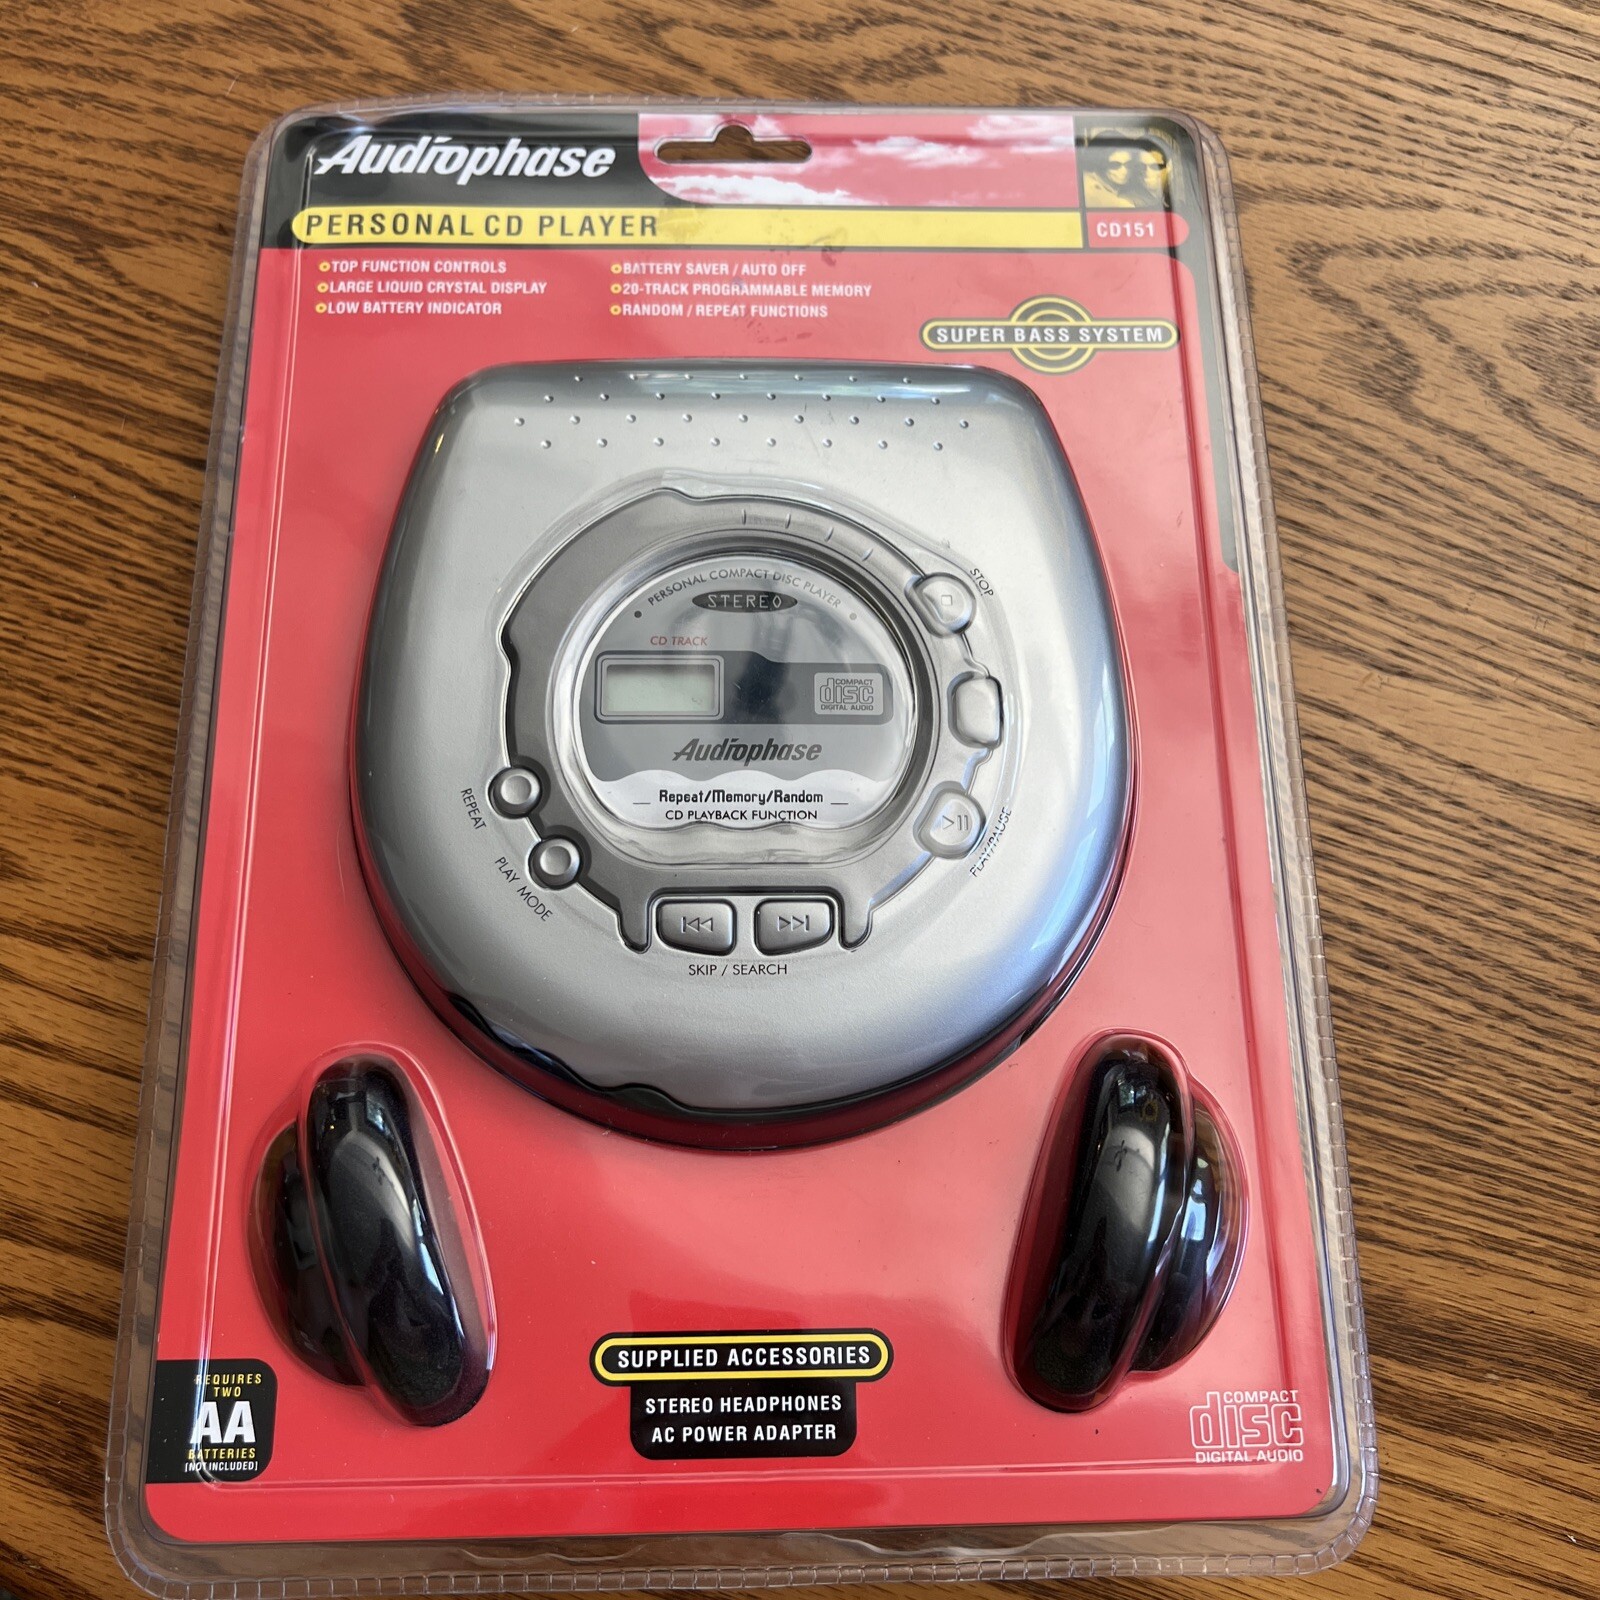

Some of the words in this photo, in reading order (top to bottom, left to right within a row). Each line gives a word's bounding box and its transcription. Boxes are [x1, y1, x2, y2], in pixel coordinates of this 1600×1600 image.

[314, 135, 616, 185] Audiophase
[306, 213, 474, 236] PERSONAL
[485, 215, 523, 236] CD
[539, 215, 657, 237] PLAYER
[1097, 222, 1154, 237] CD151
[331, 261, 358, 273] TOP
[362, 261, 430, 273] FUNCTION
[434, 261, 507, 274] CONTROLS
[623, 263, 682, 275] BATTERY
[686, 263, 729, 275] SAVER
[741, 264, 777, 276] AUTO
[781, 264, 806, 276] OFF
[329, 281, 373, 294] LARGE
[377, 281, 423, 294] LIQUID
[427, 281, 487, 294] CRYSTAL
[491, 281, 547, 294] DISPLAY
[622, 283, 689, 295] 20-TRACK
[693, 284, 808, 296] PROGRAMMABLE
[812, 285, 871, 297] MEMORY
[327, 302, 360, 314] LOW
[363, 302, 423, 315] BATTERY
[427, 302, 502, 315] INDICATOR
[622, 304, 683, 316] RANDOM
[696, 305, 746, 317] REPEAT
[751, 305, 828, 318] FUNCTIONS
[936, 327, 1005, 343] SUPER
[1014, 327, 1070, 343] BASS
[1079, 327, 1162, 342] SYSTEM
[647, 574, 706, 606] PERSONAL
[709, 568, 769, 580] COMPACT
[772, 571, 801, 588] DISC
[803, 581, 841, 608] PLAYER
[969, 567, 994, 597] STOP
[708, 594, 782, 608] STEREO
[650, 636, 667, 646] CD
[671, 636, 708, 646] TRACK
[672, 738, 822, 766] Audiophase
[461, 787, 487, 830] REPEAT
[665, 810, 683, 820] CD
[687, 810, 747, 820] PLAYBACK
[752, 810, 817, 820] FUNCTION
[969, 806, 1012, 877] PLAY/PAUSE
[495, 857, 520, 884] PLAY
[517, 885, 553, 922] MODE
[688, 964, 717, 976] SKIP
[732, 963, 788, 976] SEARCH
[618, 1349, 718, 1368] SUPPLIED
[727, 1346, 870, 1366] ACCESSORIES
[195, 1373, 262, 1385] REQUIRES
[214, 1386, 241, 1397] TWO
[1223, 1391, 1298, 1403] COMPACT
[645, 1397, 713, 1414] STEREO
[720, 1395, 842, 1412] HEADPHONES
[190, 1400, 256, 1444] AA
[1189, 1391, 1304, 1448] disc
[652, 1427, 675, 1442] AC
[683, 1426, 747, 1442] POWER
[753, 1424, 836, 1441] ADAPTER
[188, 1448, 256, 1460] BATTERIES
[1195, 1450, 1252, 1463] DIGITAL
[1257, 1449, 1303, 1462] AUDIO
